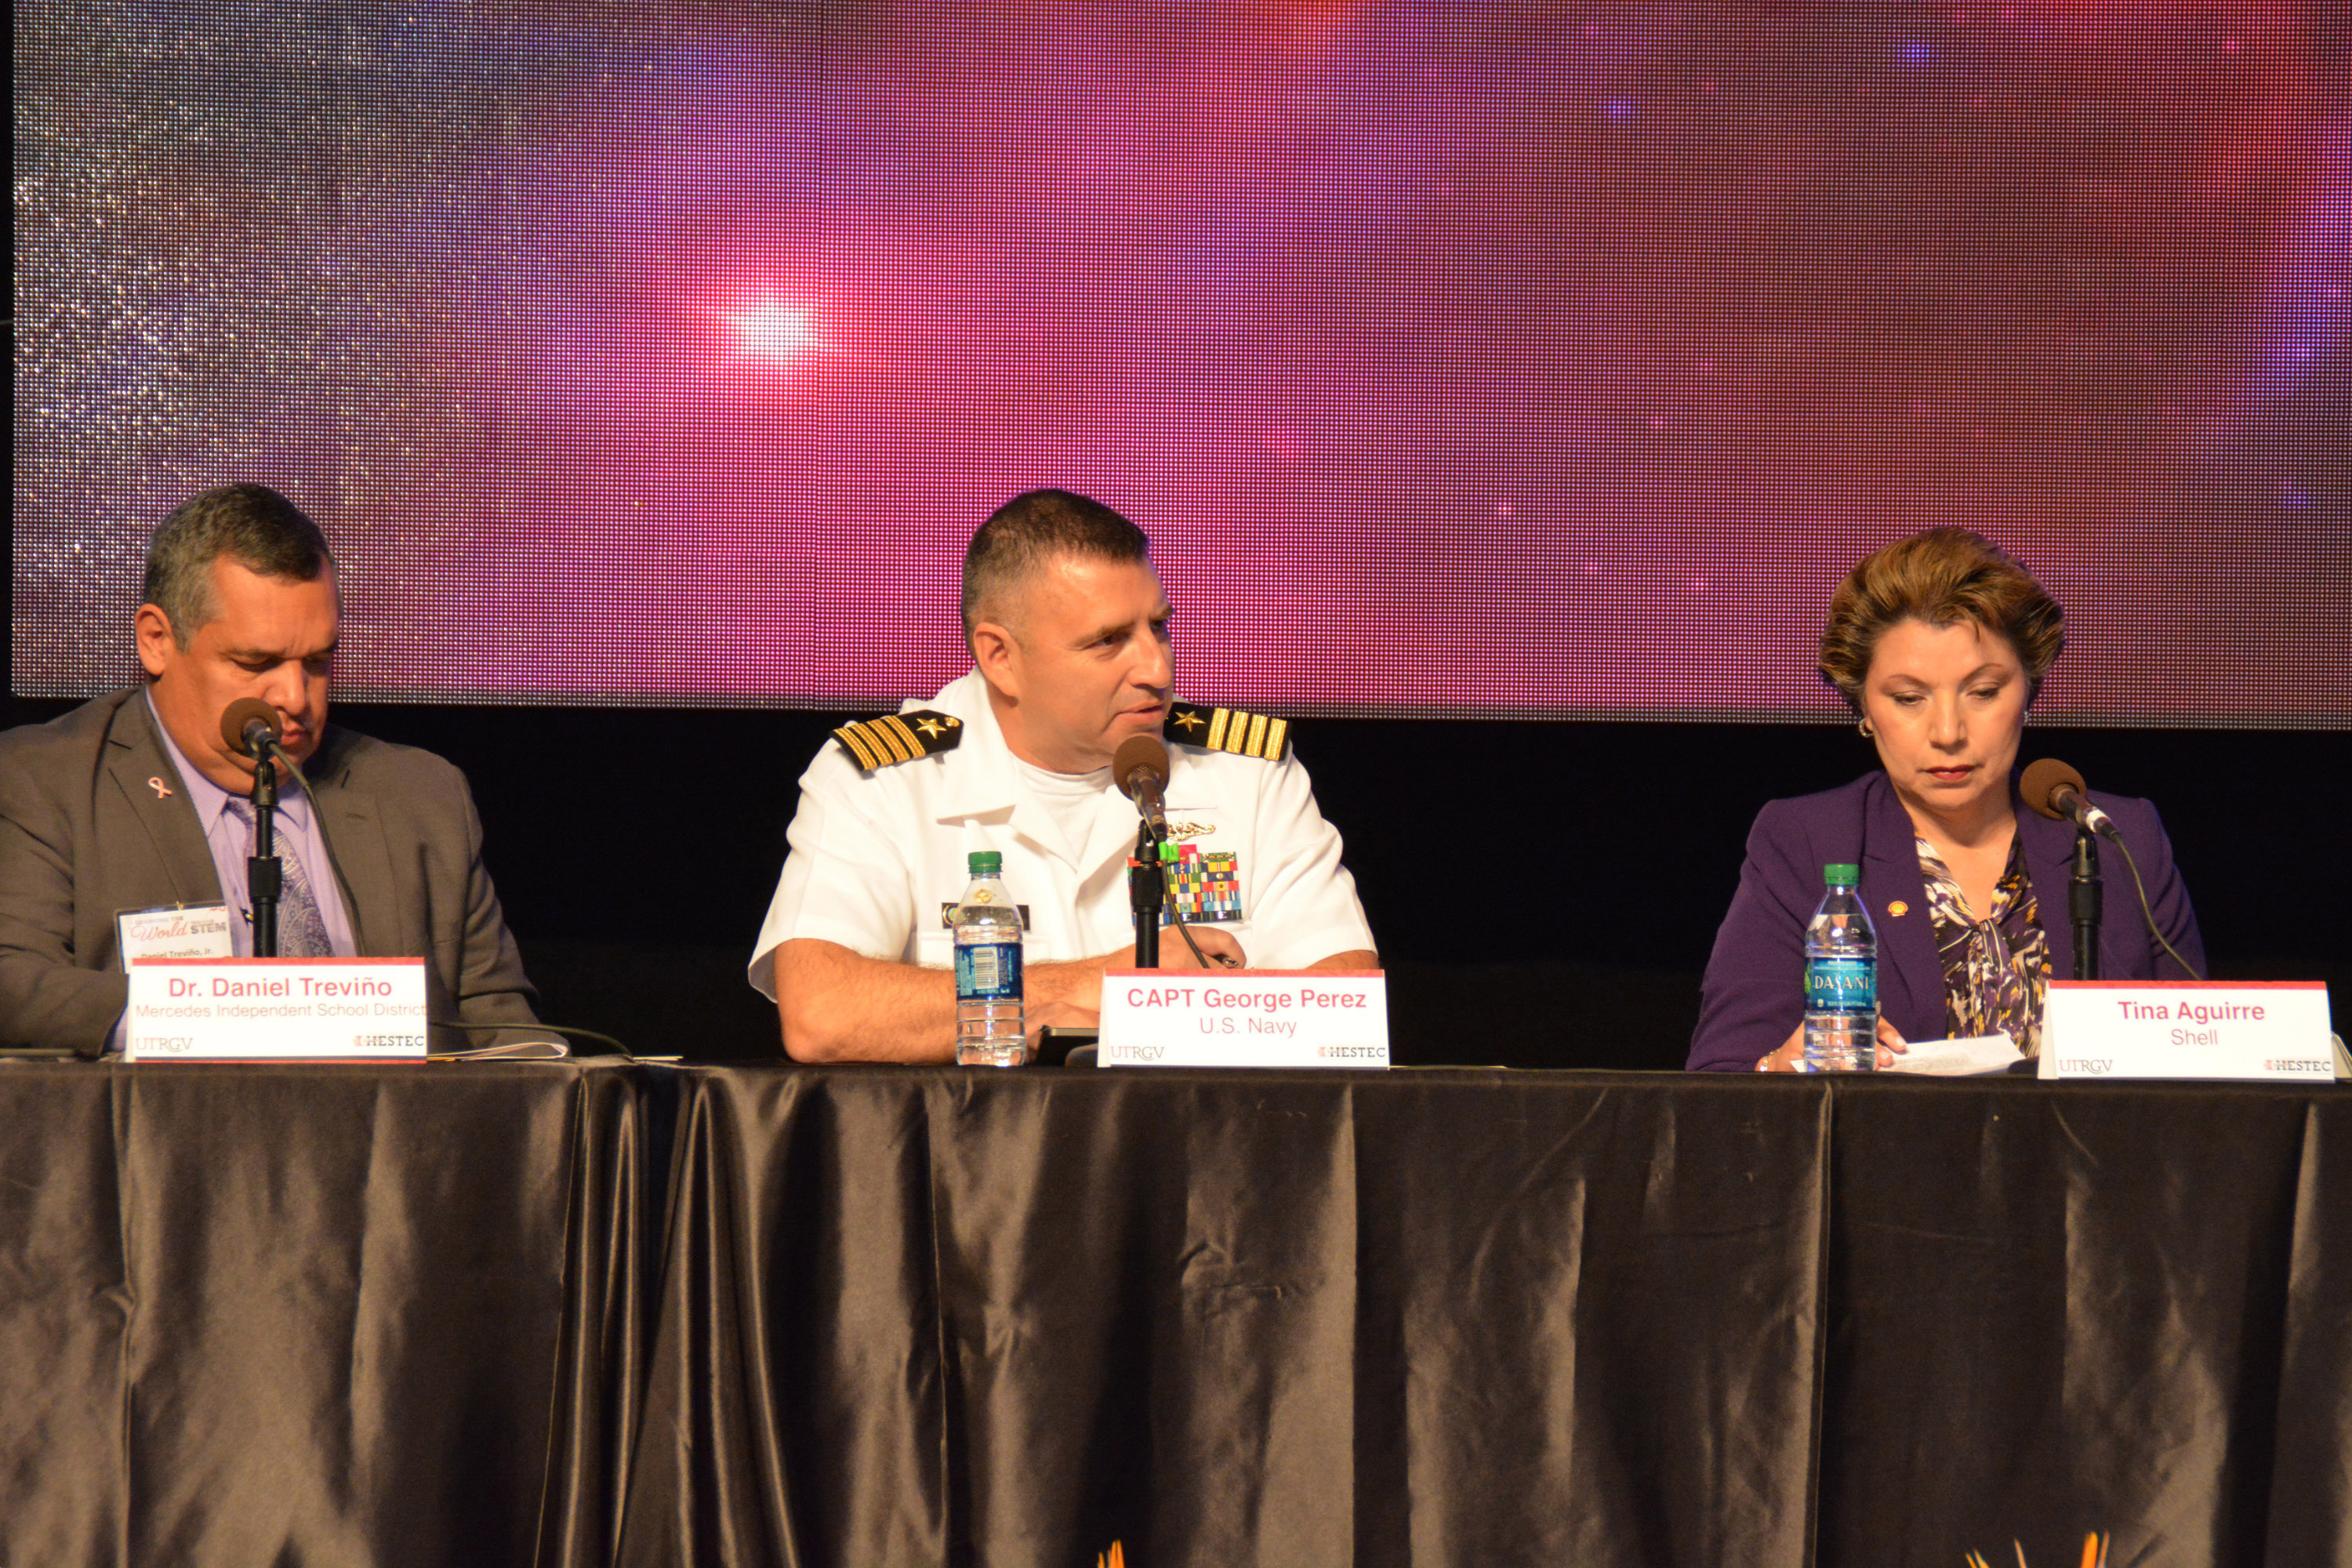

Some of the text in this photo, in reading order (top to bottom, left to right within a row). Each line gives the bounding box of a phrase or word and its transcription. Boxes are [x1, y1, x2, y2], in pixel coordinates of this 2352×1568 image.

[130, 922, 188, 942] World
[191, 922, 227, 935] STEM
[169, 977, 392, 997] Dr. Daniel Treviño
[1815, 972, 1869, 989] DASANI
[1127, 989, 1367, 1013] CAPT George Perez
[136, 1003, 427, 1019] Mercedes Independent School District
[2118, 1001, 2265, 1025] Tina Aguirre
[1200, 1017, 1297, 1038] U.S. Navy
[136, 1037, 193, 1052] UTRGV
[366, 1036, 424, 1047] HESTEC
[2171, 1029, 2218, 1045] Shell
[1110, 1046, 1165, 1061] UTRGV
[1330, 1047, 1385, 1058] HESTEC
[2059, 1059, 2113, 1074] UTRGV
[2276, 1060, 2331, 1072] HESTEC
